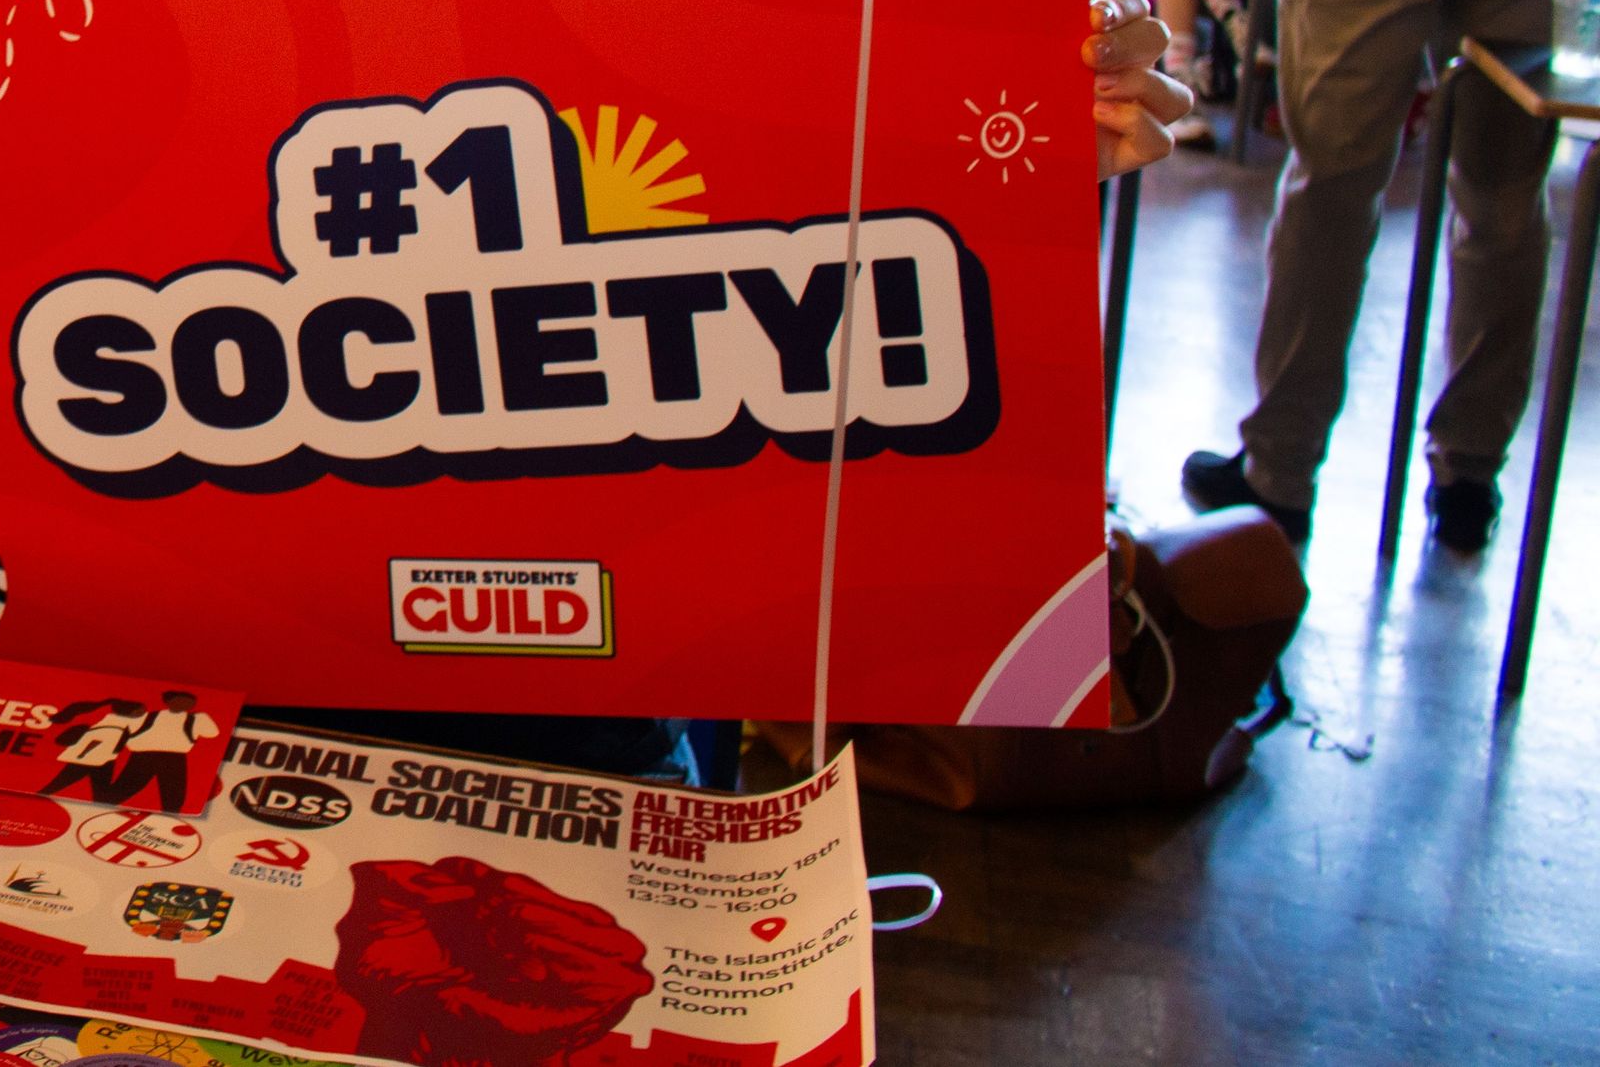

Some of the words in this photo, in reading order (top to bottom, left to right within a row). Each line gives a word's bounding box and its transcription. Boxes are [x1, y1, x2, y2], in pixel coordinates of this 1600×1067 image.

[312, 123, 525, 260] #1
[52, 256, 930, 438] SOCIETY!
[411, 570, 477, 583] EXETER
[402, 586, 589, 635] GUILD
[223, 736, 375, 784] TIONAL
[388, 760, 623, 818] SOCIETIES
[633, 762, 840, 822] ALTERNATIVE
[234, 777, 349, 820] NDSS
[370, 787, 620, 850] COALITION
[631, 811, 803, 843] FRESHERS
[629, 832, 706, 863] FAIR
[630, 858, 788, 883] Wednesday
[793, 837, 840, 870] 18th
[228, 869, 302, 888] SOCSTU
[231, 861, 303, 880] EXETER
[627, 873, 789, 899] September,
[150, 891, 209, 910] SCA
[626, 888, 698, 909] 13:30
[725, 892, 798, 913] 16:00
[662, 964, 732, 982] Arab
[740, 934, 855, 982] Institute,
[664, 946, 719, 965] The
[725, 938, 816, 966] Islamic
[662, 981, 794, 999] Common
[661, 997, 748, 1016] Room
